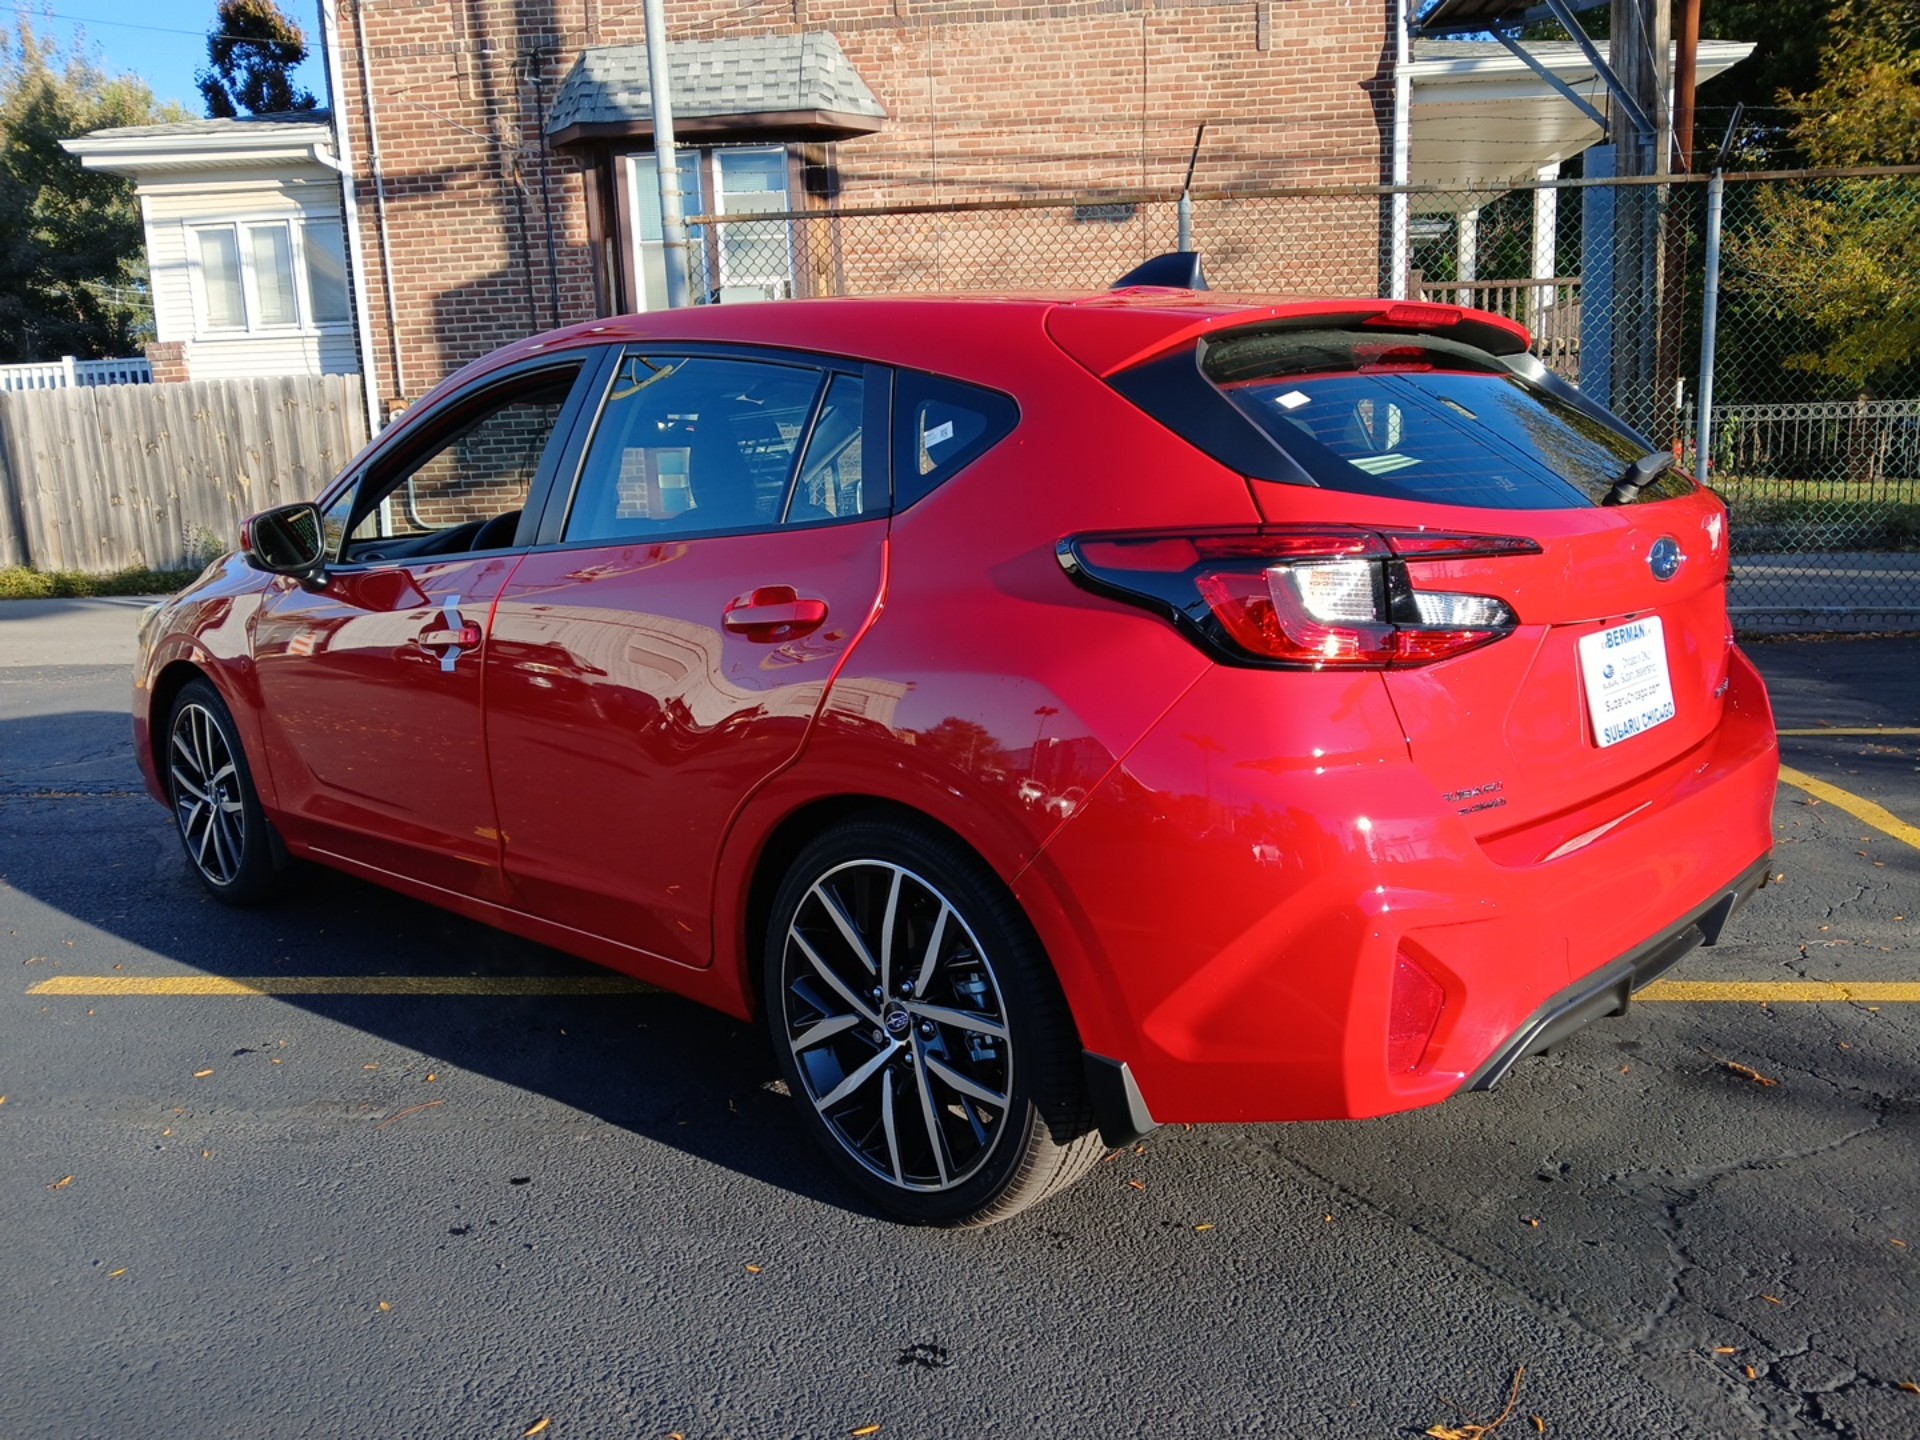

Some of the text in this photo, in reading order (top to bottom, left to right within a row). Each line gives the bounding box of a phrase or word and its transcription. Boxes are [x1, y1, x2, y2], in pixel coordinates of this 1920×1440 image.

[1605, 623, 1646, 648] BERMAN
[1604, 701, 1673, 744] SUBARU CHICAGO
